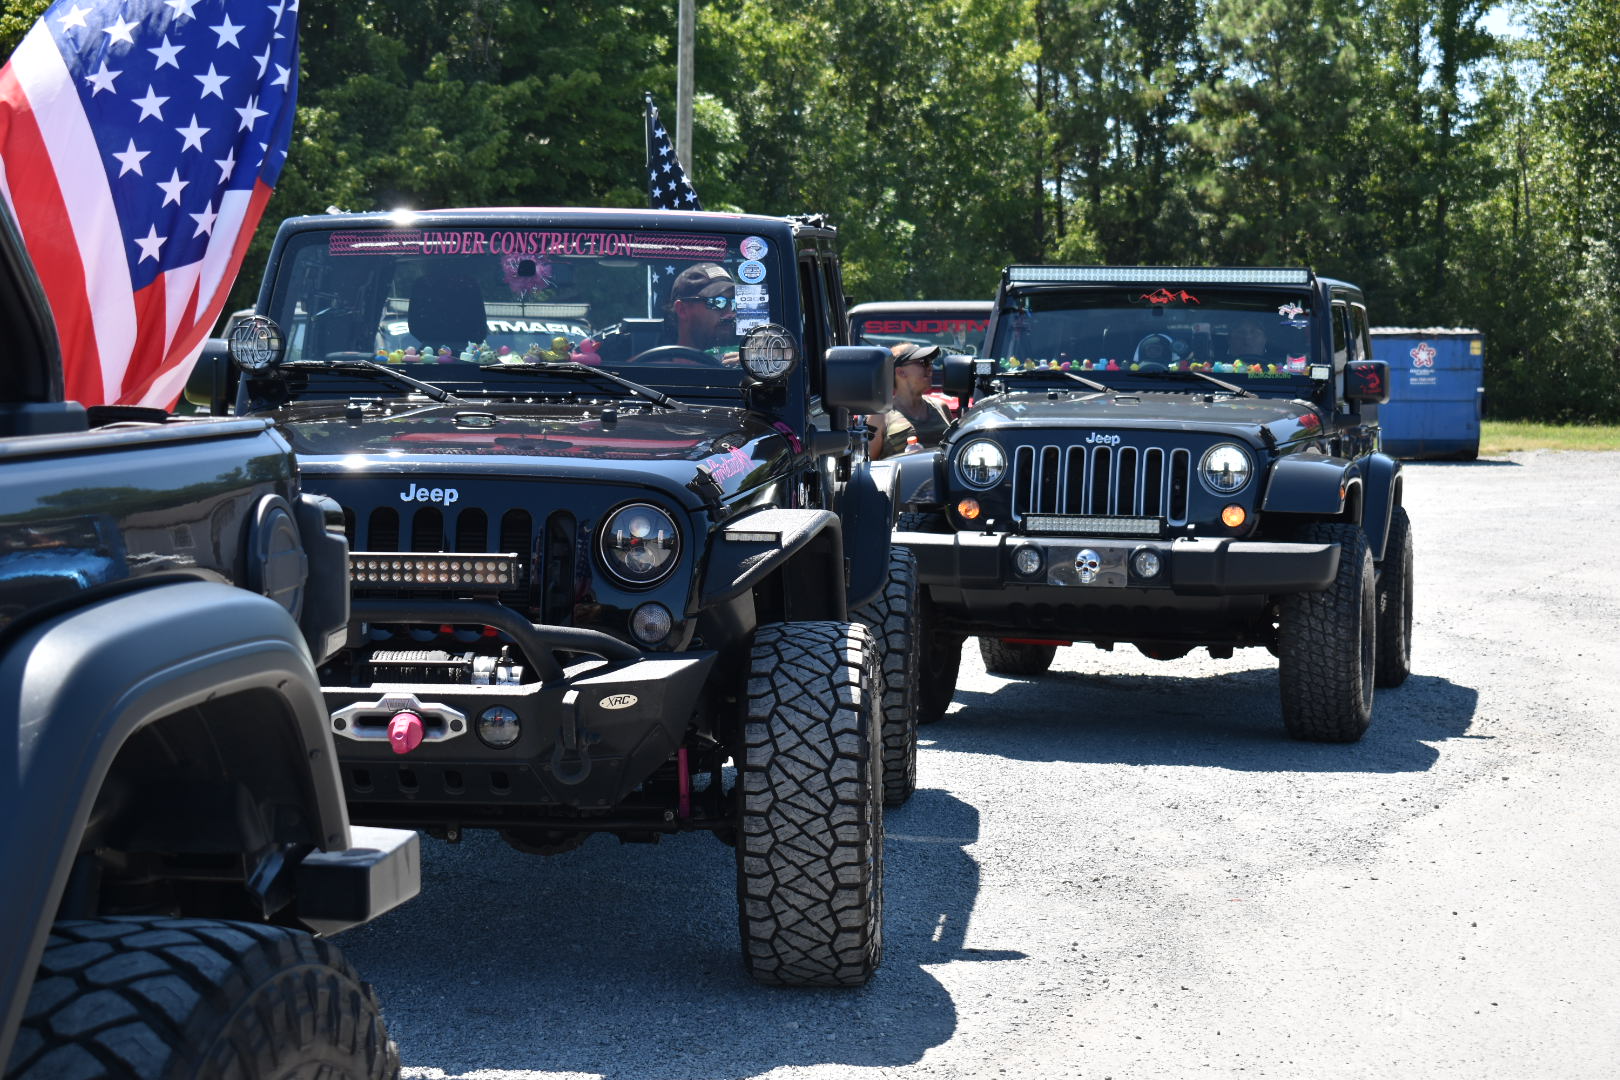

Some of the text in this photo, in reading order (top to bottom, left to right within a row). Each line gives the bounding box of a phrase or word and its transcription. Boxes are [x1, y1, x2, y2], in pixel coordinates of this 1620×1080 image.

[423, 231, 633, 257] UNDER CONSTRUCTION
[1085, 431, 1121, 447] Jeep
[399, 483, 459, 507] Jeep
[606, 695, 631, 707] XRC
